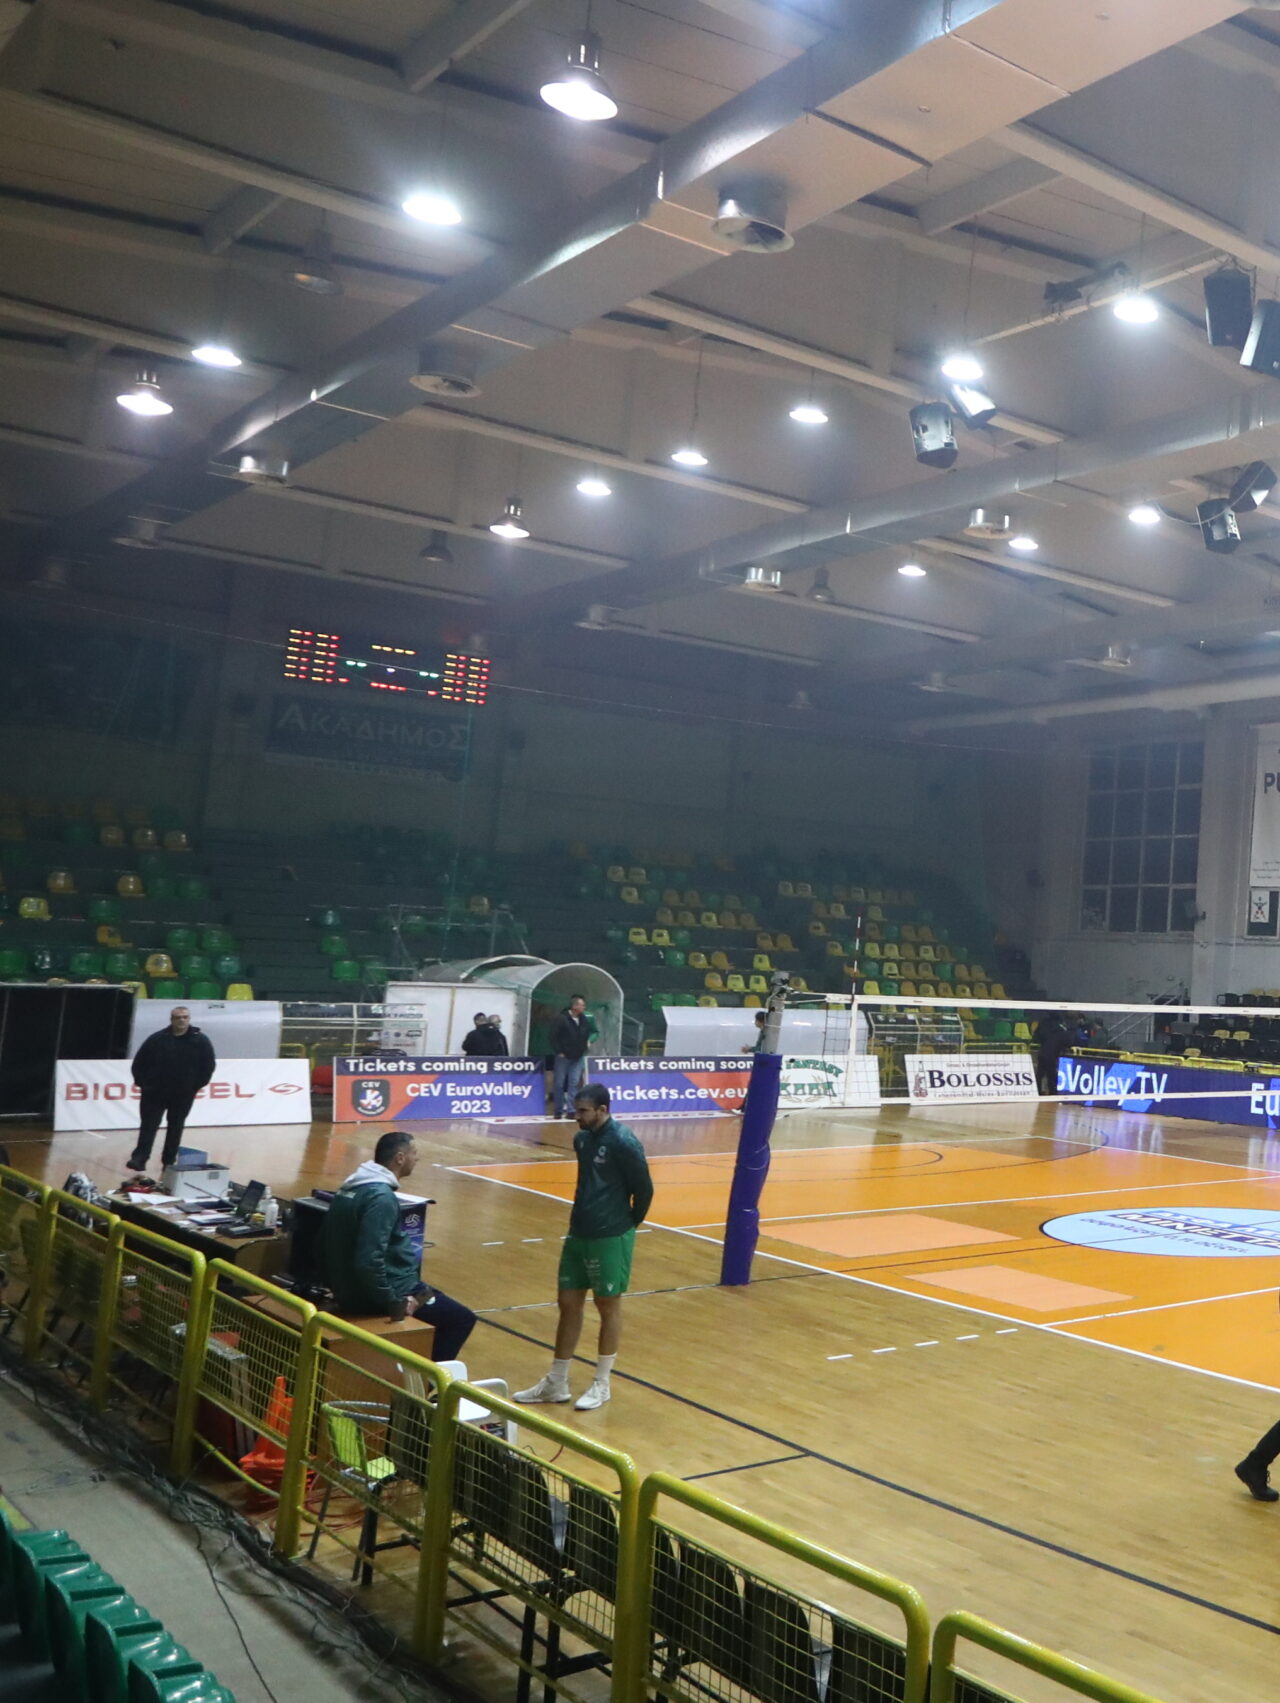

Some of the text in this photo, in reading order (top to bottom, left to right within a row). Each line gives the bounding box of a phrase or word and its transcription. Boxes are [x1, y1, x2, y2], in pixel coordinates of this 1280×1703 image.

[346, 1058, 535, 1075] Tickets coming soon
[594, 1058, 654, 1071] Tickets
[658, 1057, 716, 1073] coming
[361, 1081, 382, 1089] CEV
[928, 1069, 1034, 1089] BOLOSSIS
[406, 1082, 532, 1099] CEV EuroVolley
[609, 1083, 748, 1102] tickets.cev.eu
[451, 1100, 491, 1115] 2023
